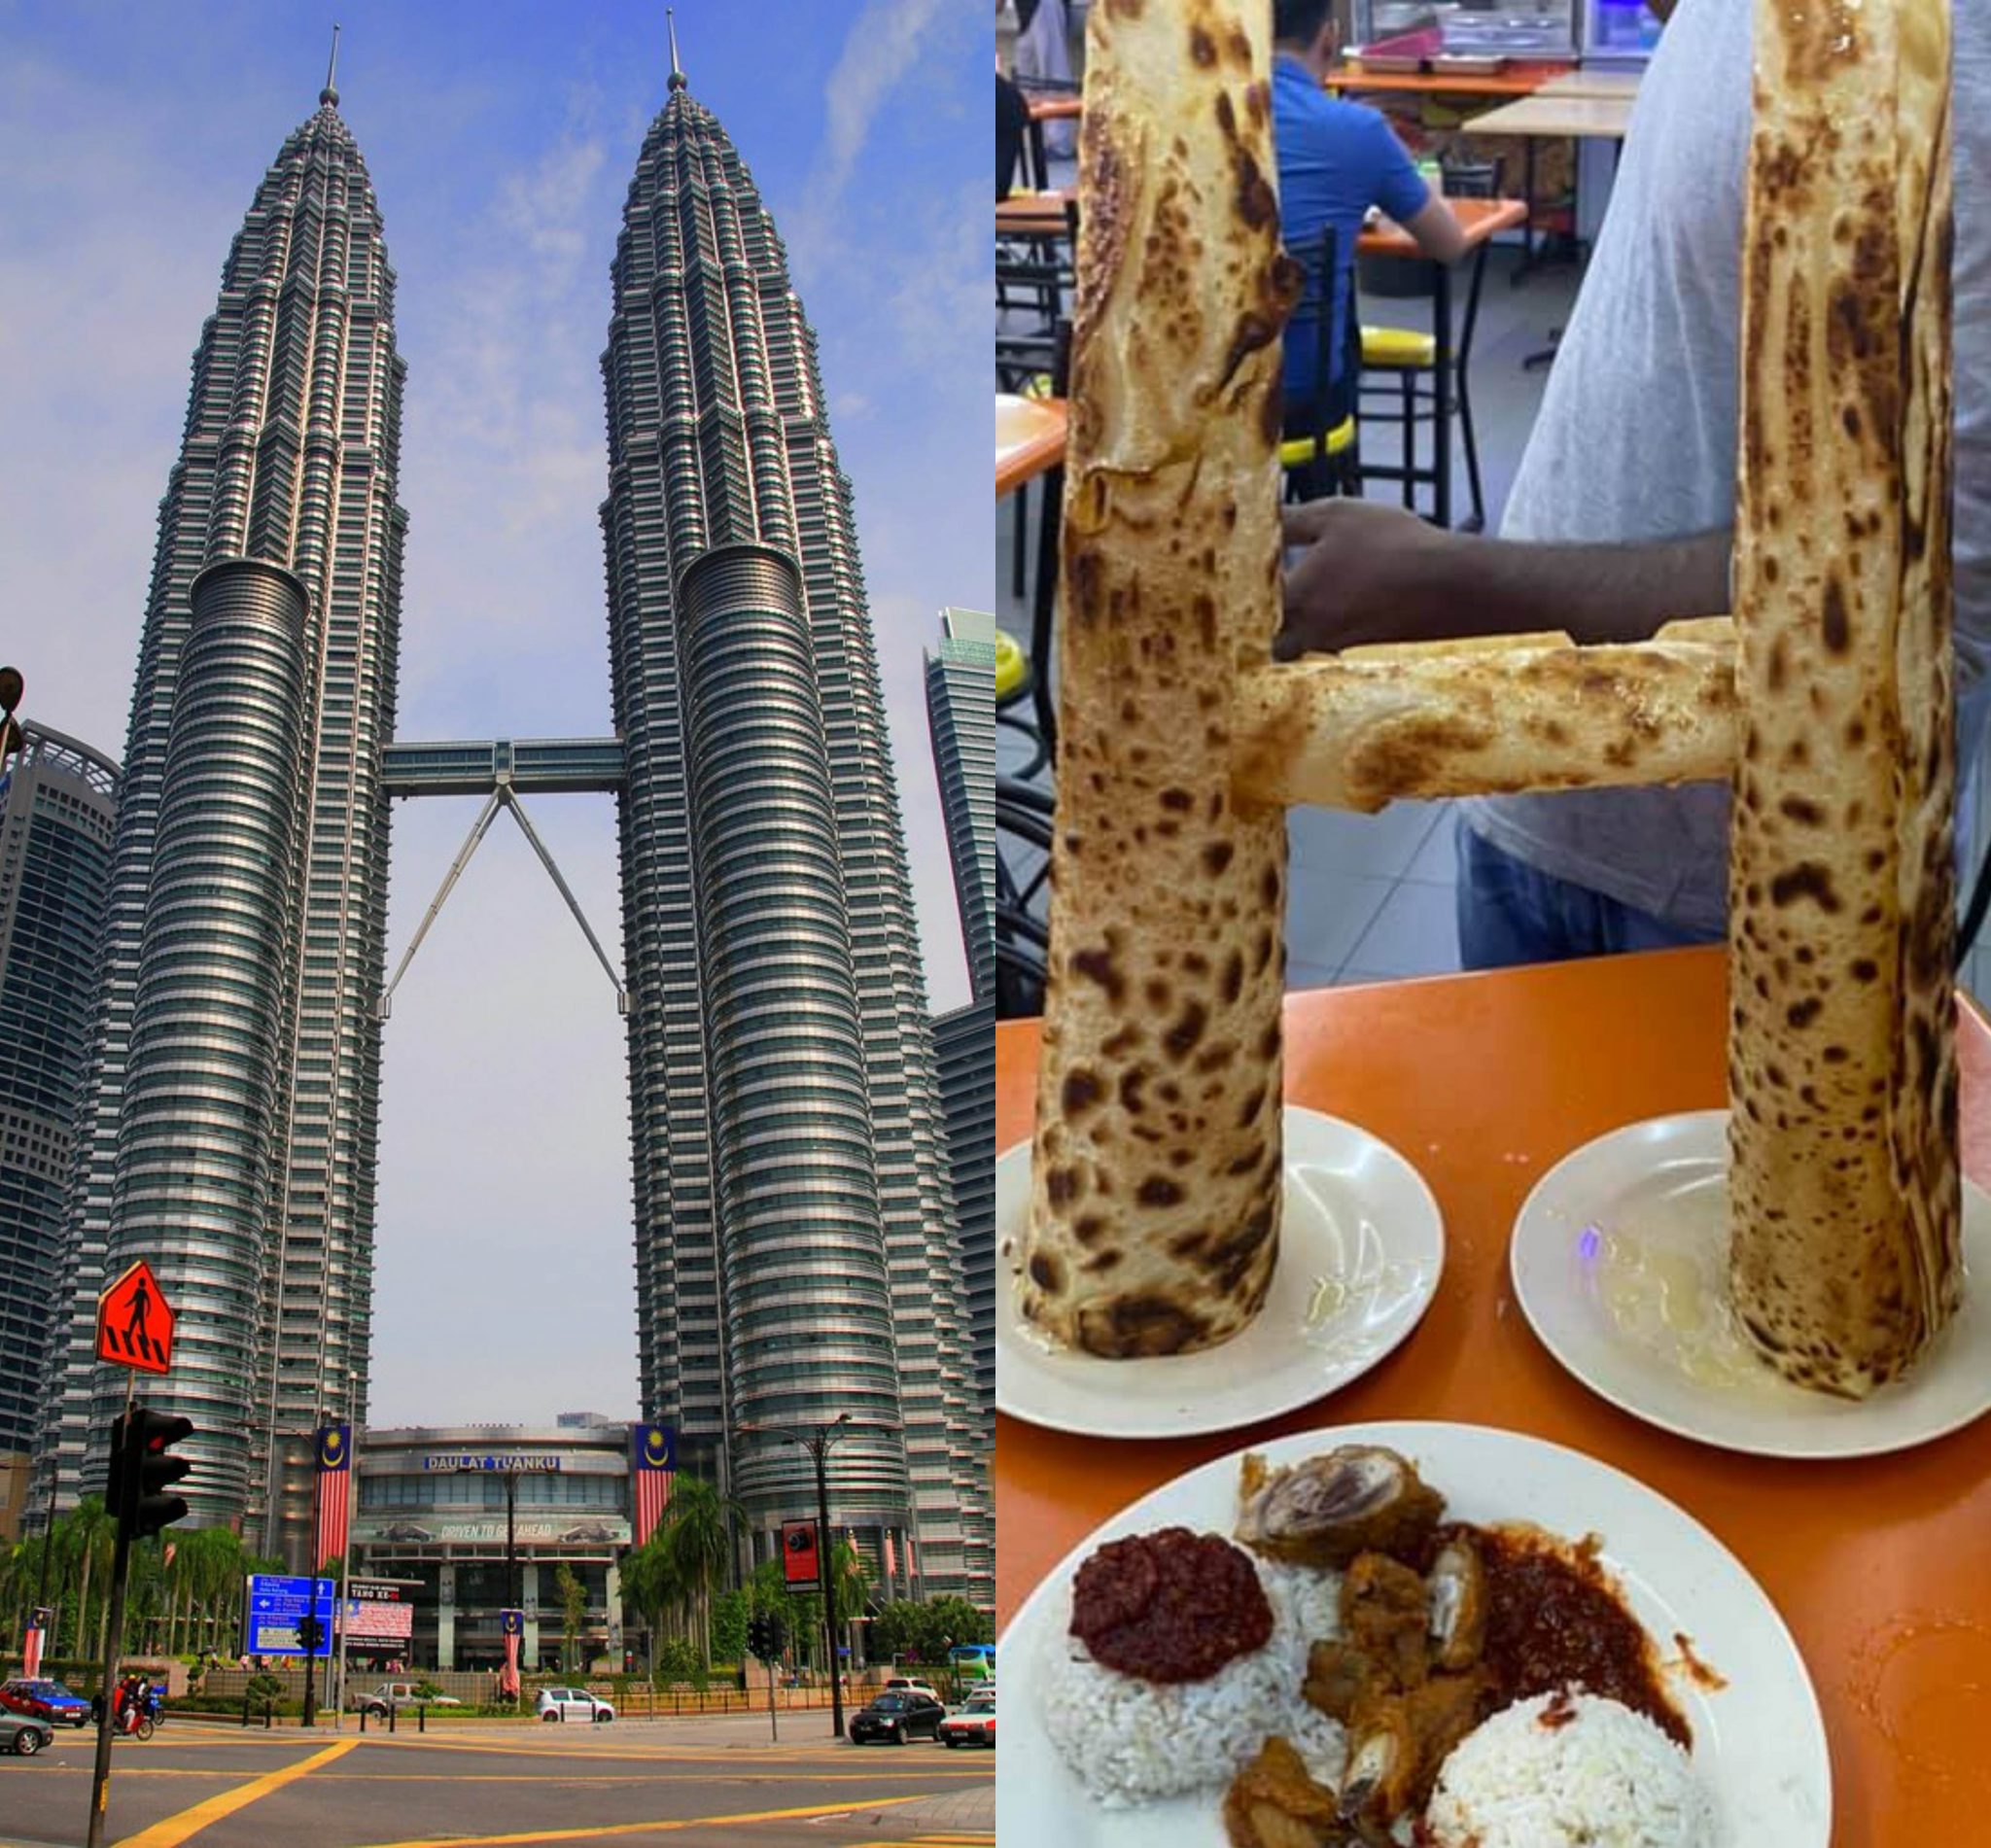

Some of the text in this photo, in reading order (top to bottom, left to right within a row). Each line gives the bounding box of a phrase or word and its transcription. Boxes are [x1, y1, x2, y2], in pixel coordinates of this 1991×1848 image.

[429, 1456, 557, 1470] DAULAT TUANKU
[441, 1525, 478, 1538] DRIVEN
[480, 1524, 494, 1537] TO
[517, 1523, 551, 1536] AHEAD
